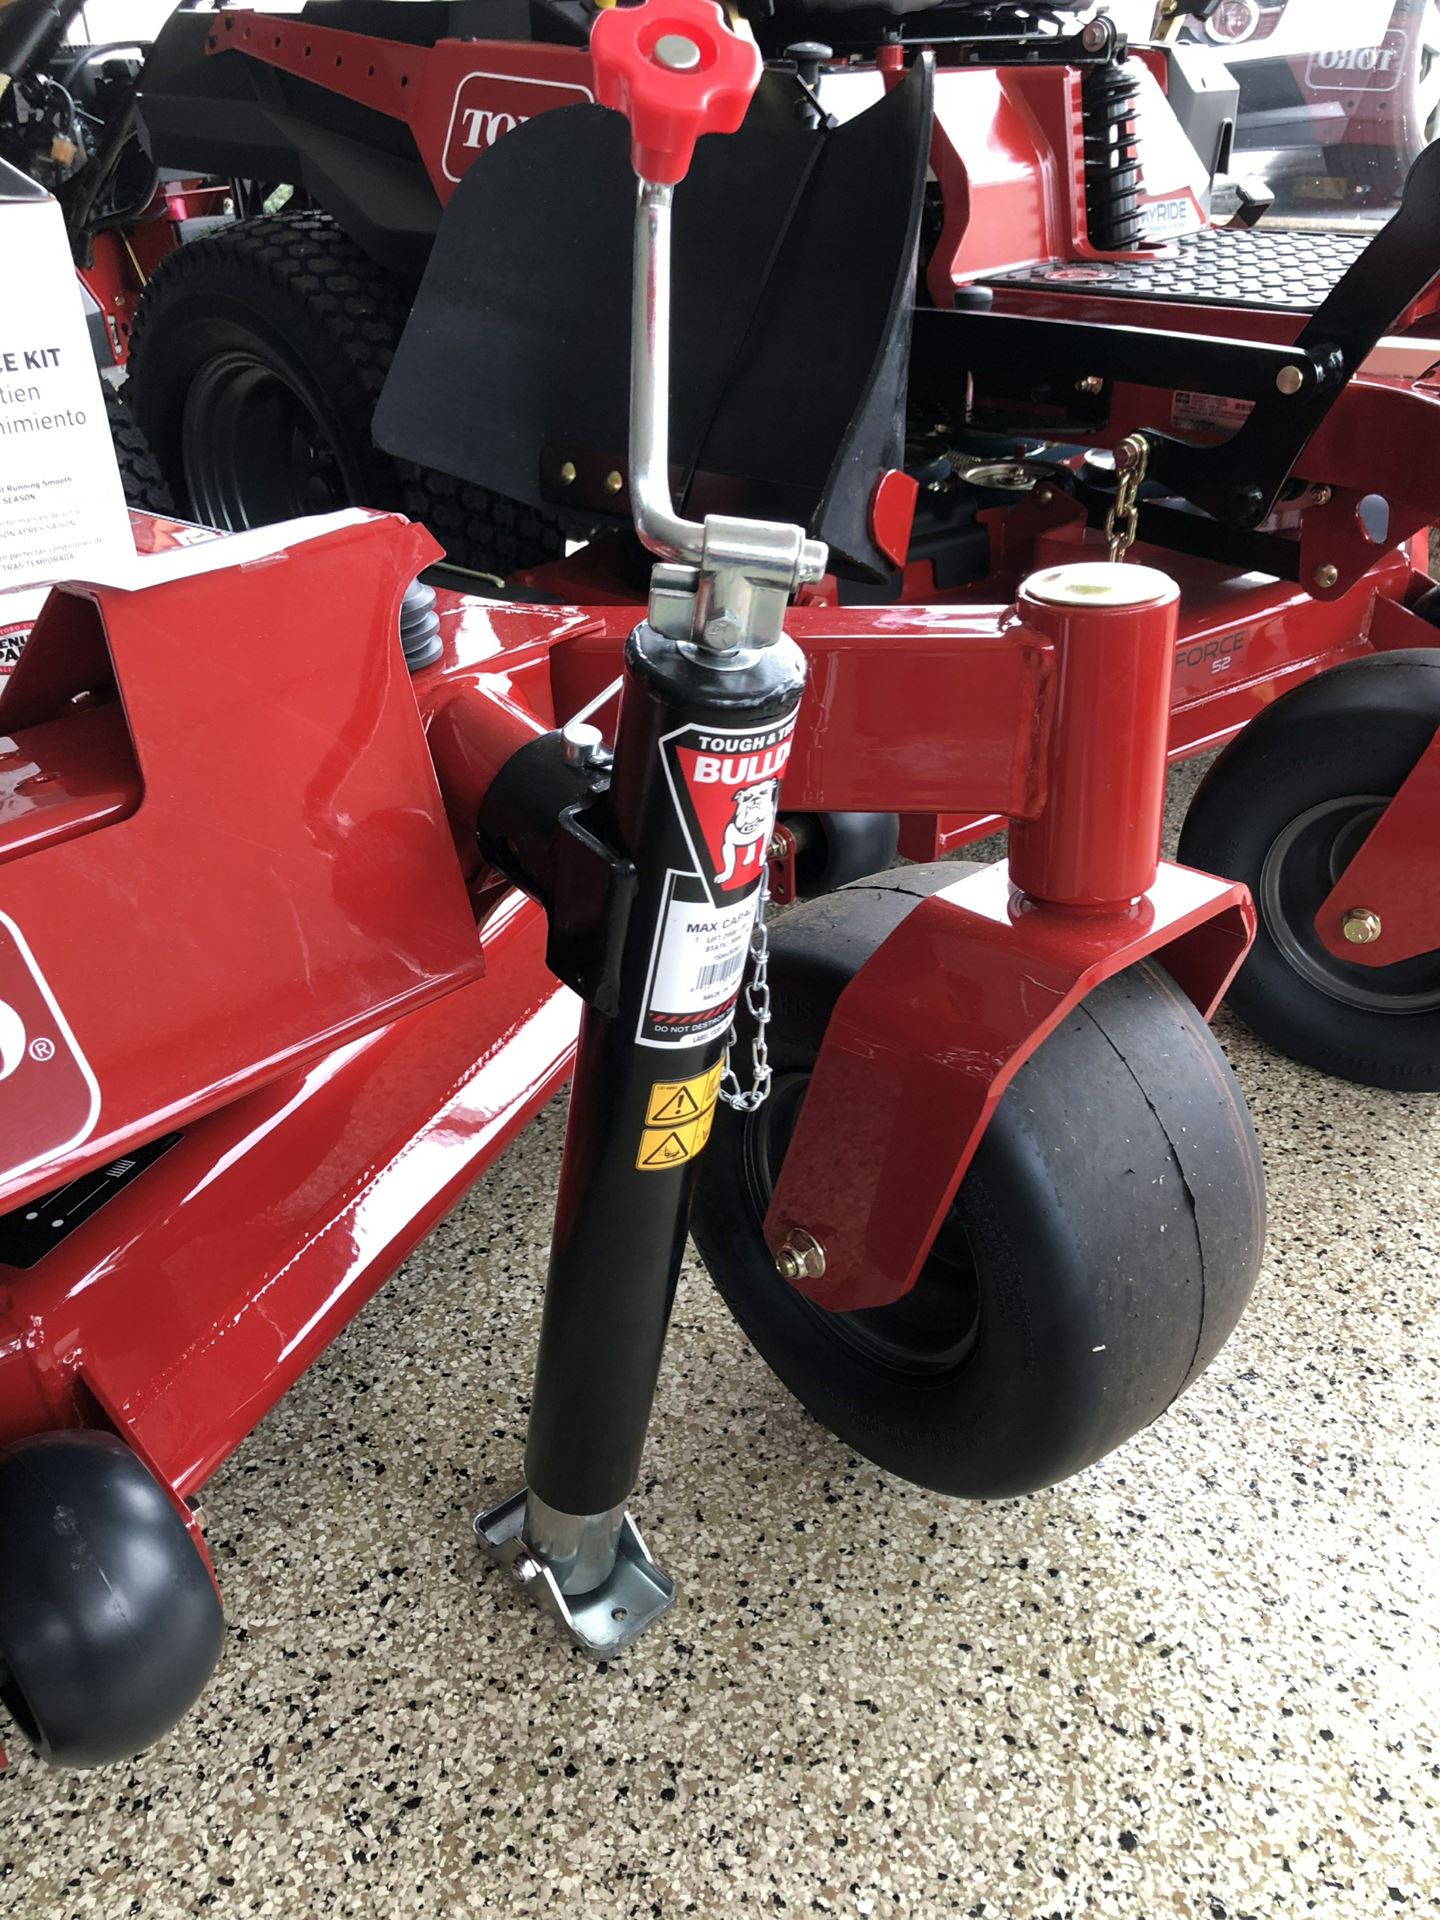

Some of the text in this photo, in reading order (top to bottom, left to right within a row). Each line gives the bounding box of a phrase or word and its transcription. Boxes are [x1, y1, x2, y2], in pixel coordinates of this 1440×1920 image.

[462, 108, 530, 148] TO
[0, 347, 61, 373] E KIT
[7, 482, 40, 491] Running
[42, 477, 72, 488] Smooth
[3, 494, 36, 504] SEASON
[26, 552, 75, 568] TEMPORADA
[1175, 631, 1246, 674] FORCE
[1211, 656, 1231, 674] 52
[698, 734, 765, 752] TOUGH
[766, 732, 776, 746] &
[686, 922, 718, 933] MAX
[654, 1024, 669, 1033] DO
[670, 1025, 691, 1033] NOT
